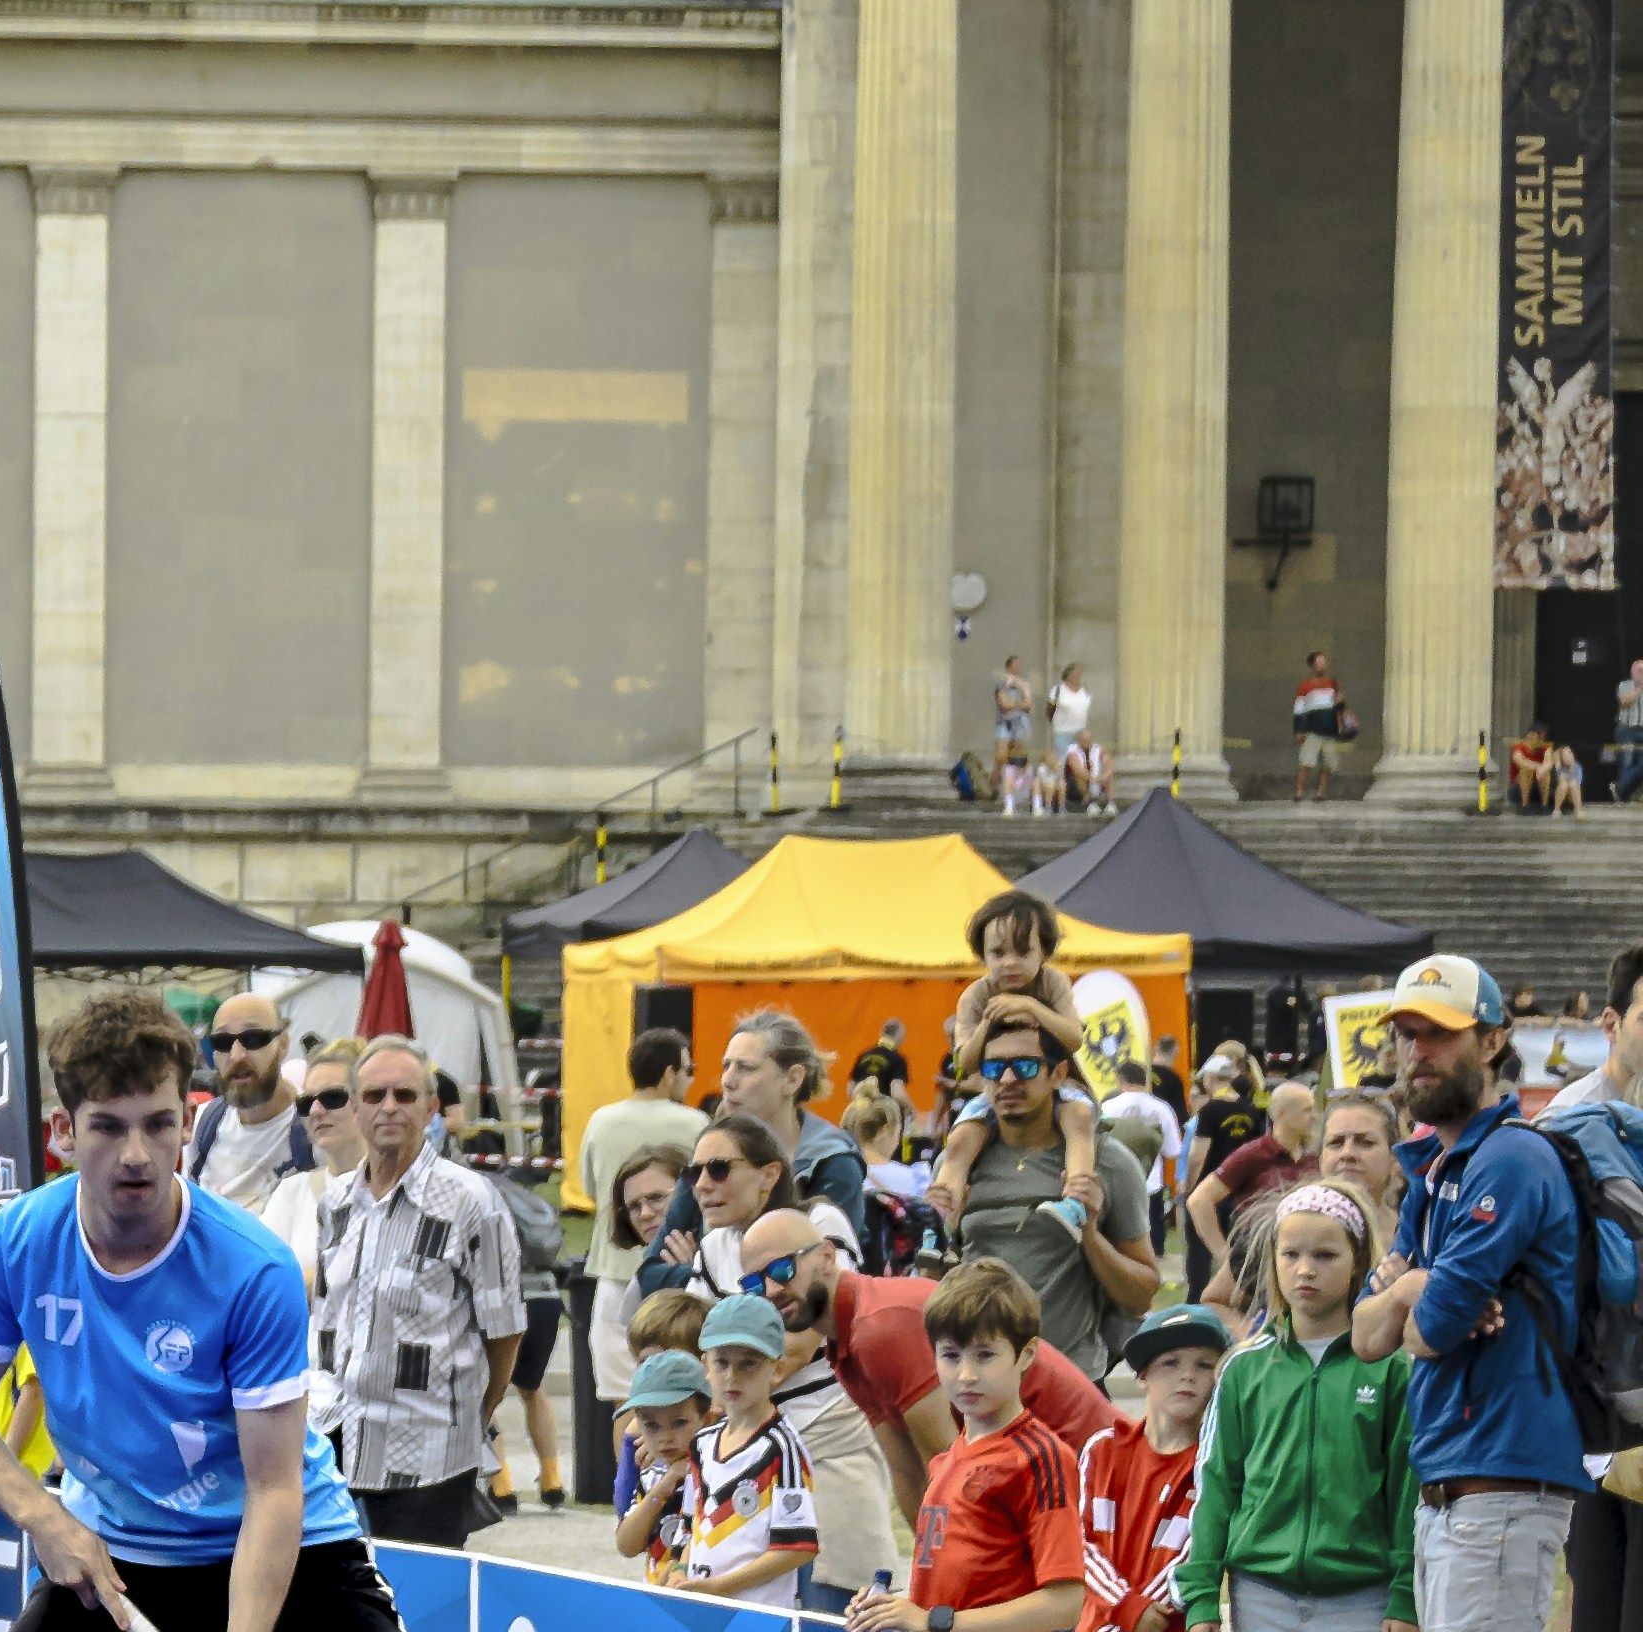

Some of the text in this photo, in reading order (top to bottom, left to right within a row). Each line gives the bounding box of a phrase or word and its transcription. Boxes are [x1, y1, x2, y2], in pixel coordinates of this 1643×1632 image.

[1515, 135, 1546, 347] SAMMELN
[1552, 154, 1584, 326] MIT STIL
[35, 1293, 84, 1346] 17
